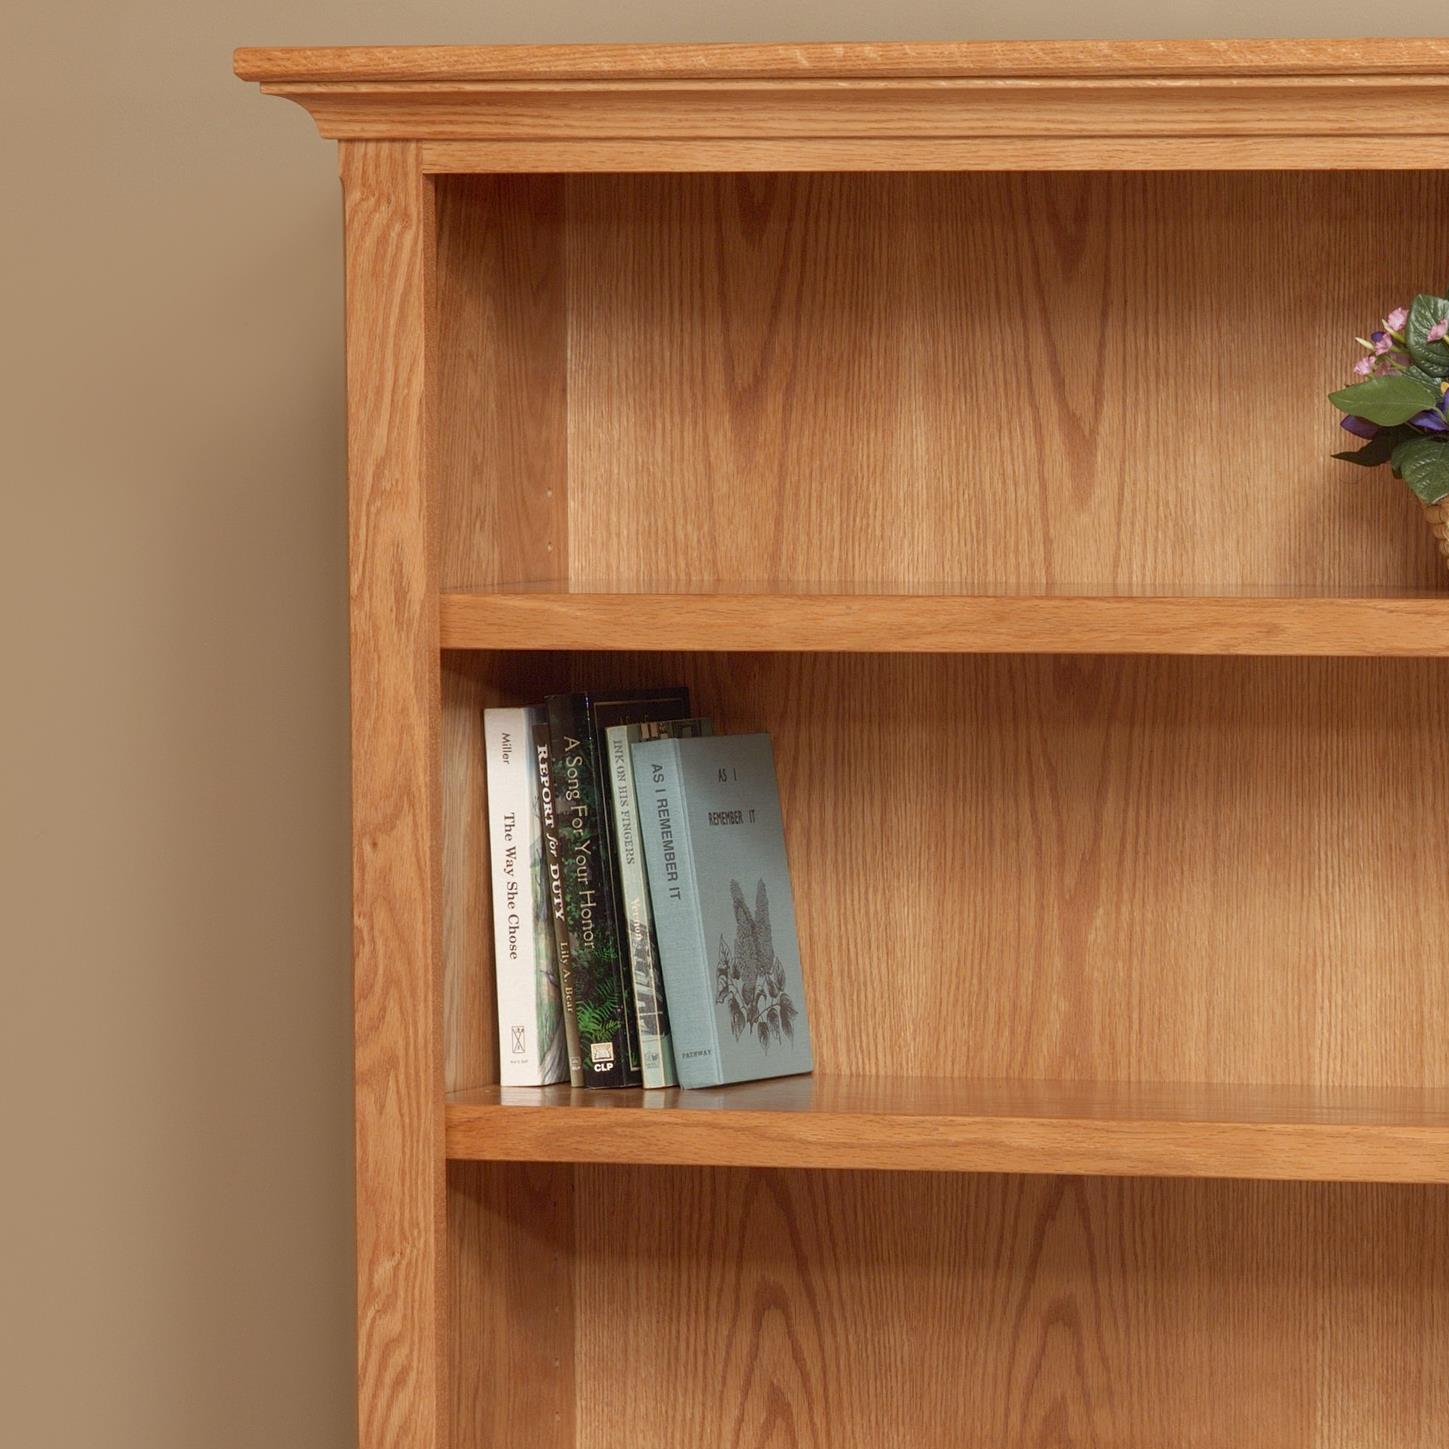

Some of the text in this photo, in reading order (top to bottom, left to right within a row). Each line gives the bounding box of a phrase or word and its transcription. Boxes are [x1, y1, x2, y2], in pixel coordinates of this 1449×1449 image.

[501, 732, 513, 764] Miller
[651, 763, 665, 784] AS
[717, 768, 728, 783] AS
[613, 740, 635, 865] INK ON HIS FINGERS
[708, 809, 756, 826] REMEMBER IT
[537, 744, 566, 923] REPORT for DUTY
[563, 736, 597, 951] A Song For Your Honor
[656, 798, 678, 882] REMEMBER
[504, 812, 520, 960] The Way She Chose
[669, 887, 681, 900] IT
[559, 942, 576, 1013] Lily A. Bear
[594, 1063, 614, 1073] CLP
[681, 1049, 713, 1060] PATHWAY
